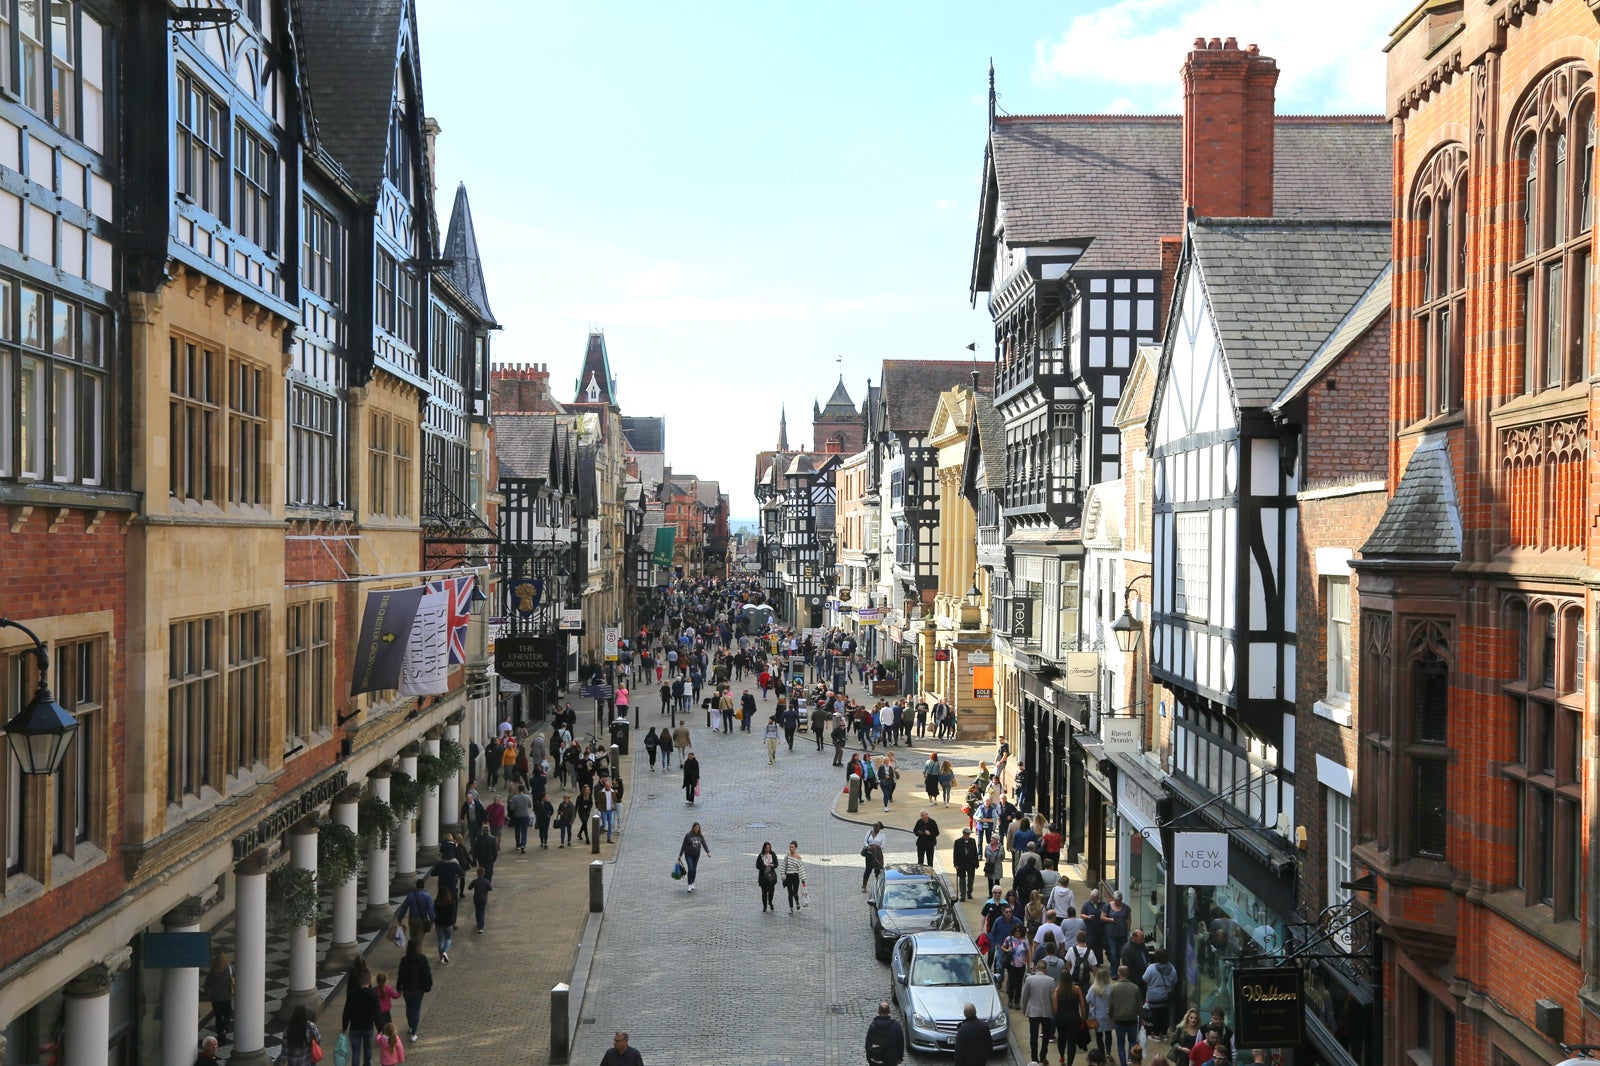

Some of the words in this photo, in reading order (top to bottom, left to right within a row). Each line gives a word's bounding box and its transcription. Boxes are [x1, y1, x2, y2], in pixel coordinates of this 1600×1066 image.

[380, 594, 391, 608] THE
[372, 608, 386, 641] CHESTER
[1014, 602, 1026, 634] next
[411, 614, 424, 679] HOTELS
[423, 612, 437, 676] LUXURY
[437, 608, 447, 676] SMALL
[234, 828, 259, 861] THE
[260, 799, 302, 843] CHESTER
[1181, 859, 1222, 869] LOOK
[1184, 850, 1220, 859] NEW
[1241, 984, 1297, 1002] Waltons
